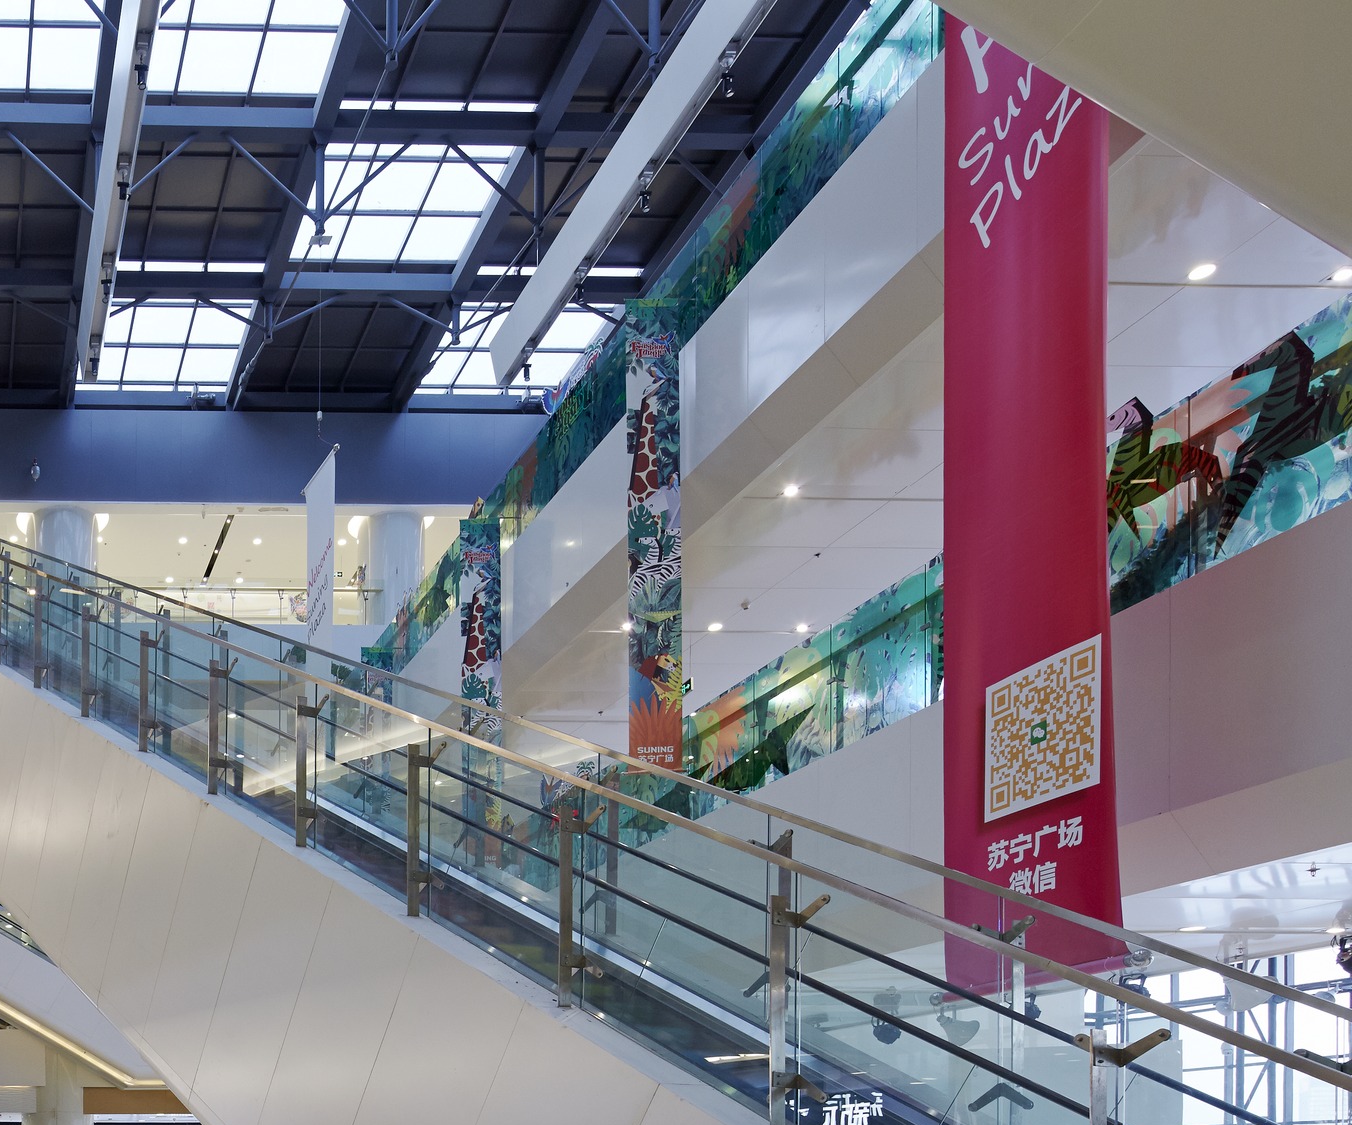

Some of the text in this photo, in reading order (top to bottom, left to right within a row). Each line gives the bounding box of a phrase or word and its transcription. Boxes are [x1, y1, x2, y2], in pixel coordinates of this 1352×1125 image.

[637, 745, 674, 754] SUNING
[987, 816, 1083, 872] 苏宁广场
[1009, 861, 1057, 895] 微信
